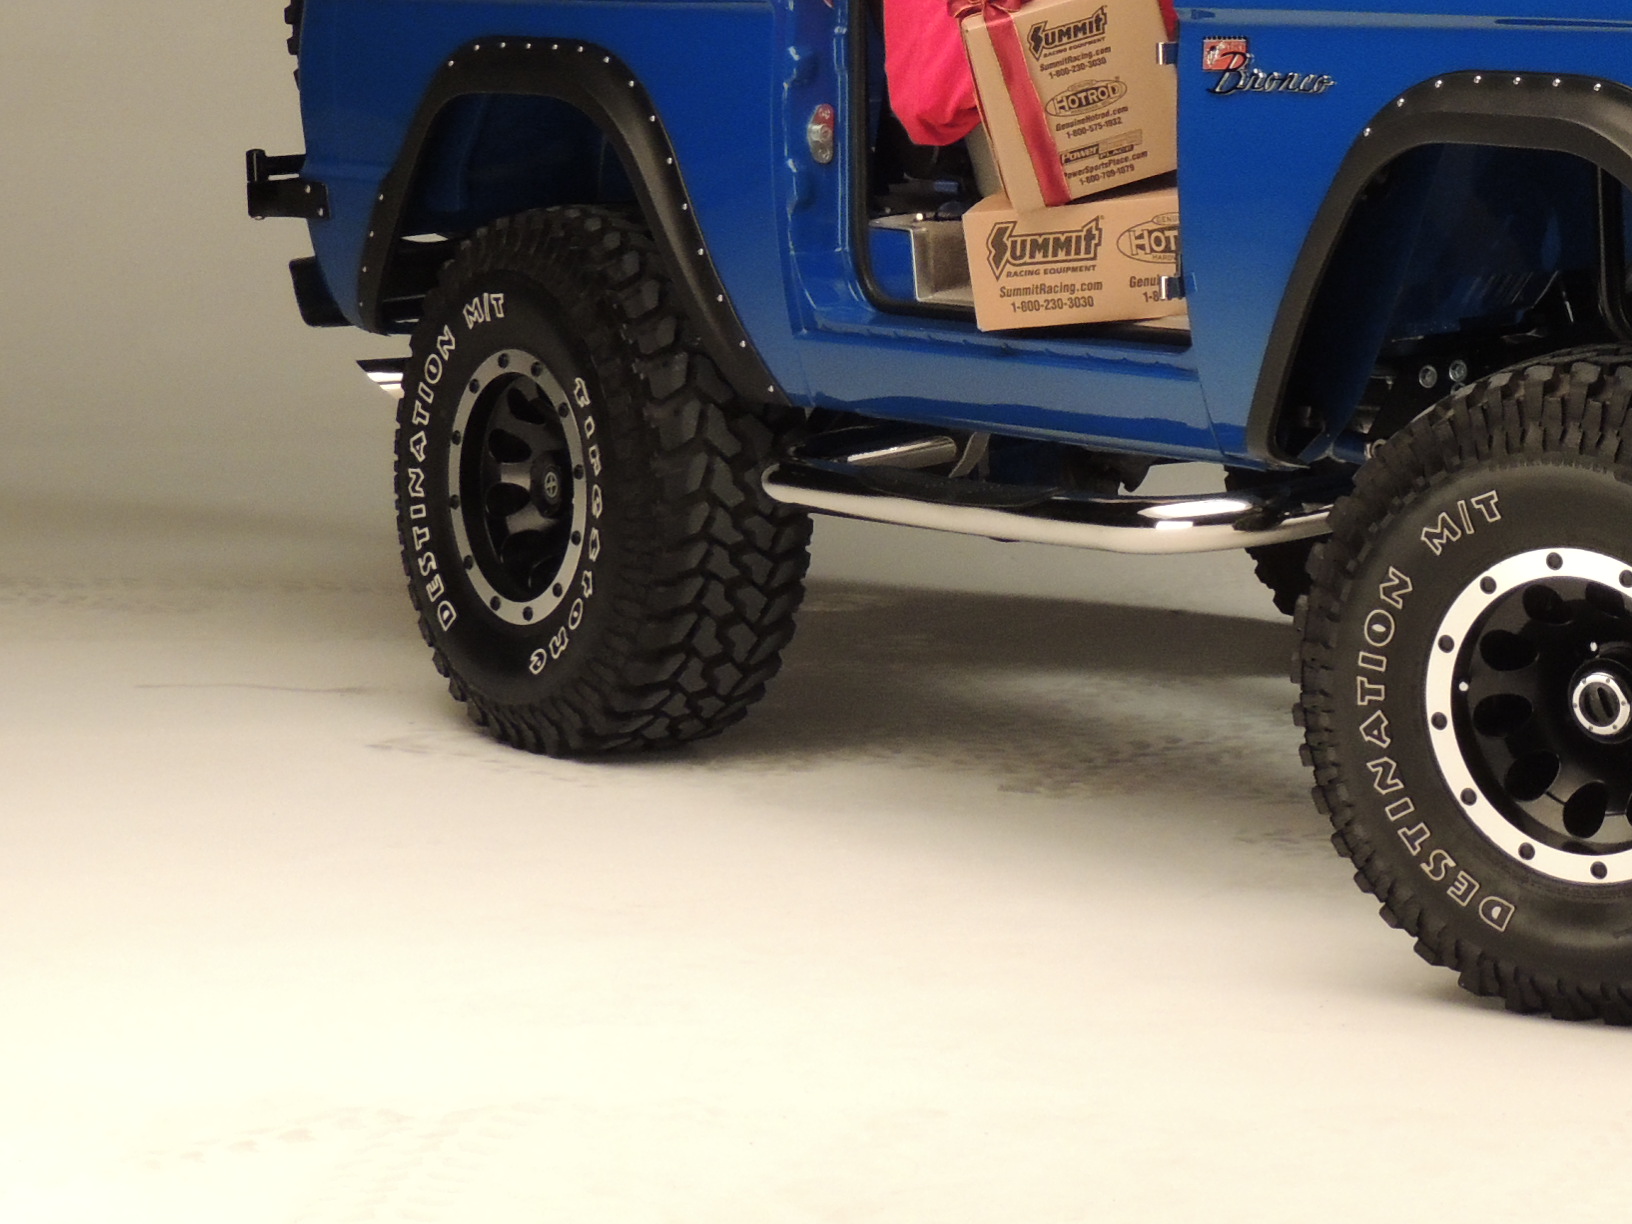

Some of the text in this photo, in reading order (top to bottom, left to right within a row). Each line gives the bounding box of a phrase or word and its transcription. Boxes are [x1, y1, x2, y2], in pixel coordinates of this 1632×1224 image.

[1027, 5, 1107, 61] SUMMIT
[1040, 46, 1112, 72] SummitRacing.com
[1049, 57, 1107, 79] 1-800-230-3030
[1206, 51, 1337, 95] Bronco
[987, 215, 1103, 282] SUMMIT
[1006, 264, 1097, 278] RACING EQUIPMENT
[999, 280, 1103, 298] SummitRacing.com
[1010, 295, 1094, 313] 1-800-230-3030
[408, 292, 505, 632] DESTINATION M/T
[1356, 489, 1515, 932] DESTINATION M/T
